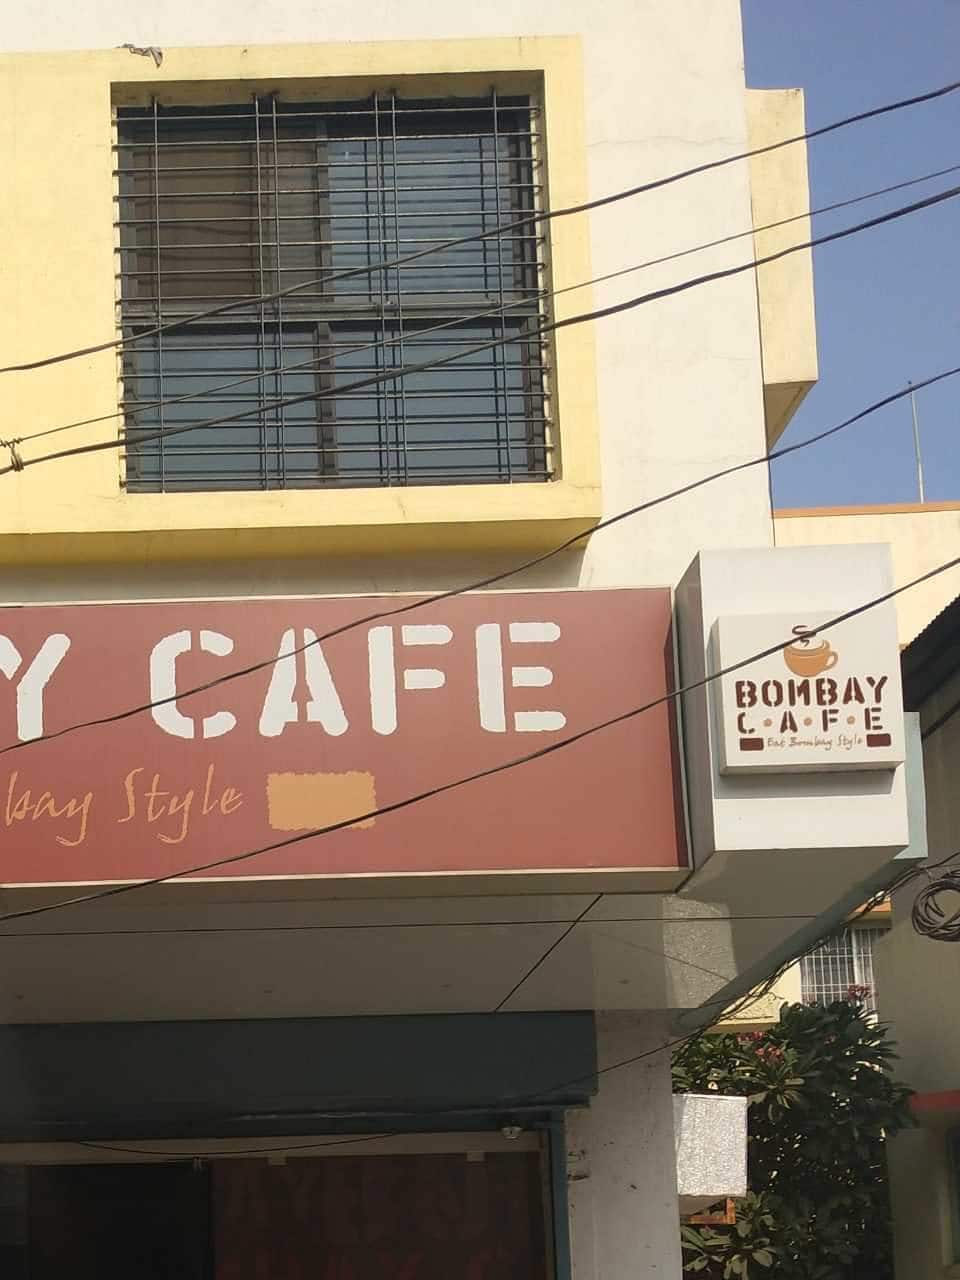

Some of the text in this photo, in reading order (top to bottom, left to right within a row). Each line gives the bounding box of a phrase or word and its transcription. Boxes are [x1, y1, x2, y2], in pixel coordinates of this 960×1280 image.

[149, 622, 567, 739] CAFE
[735, 676, 888, 708] BOMBAY
[767, 733, 864, 750] Eat Bombay Style
[116, 763, 244, 844] Style
